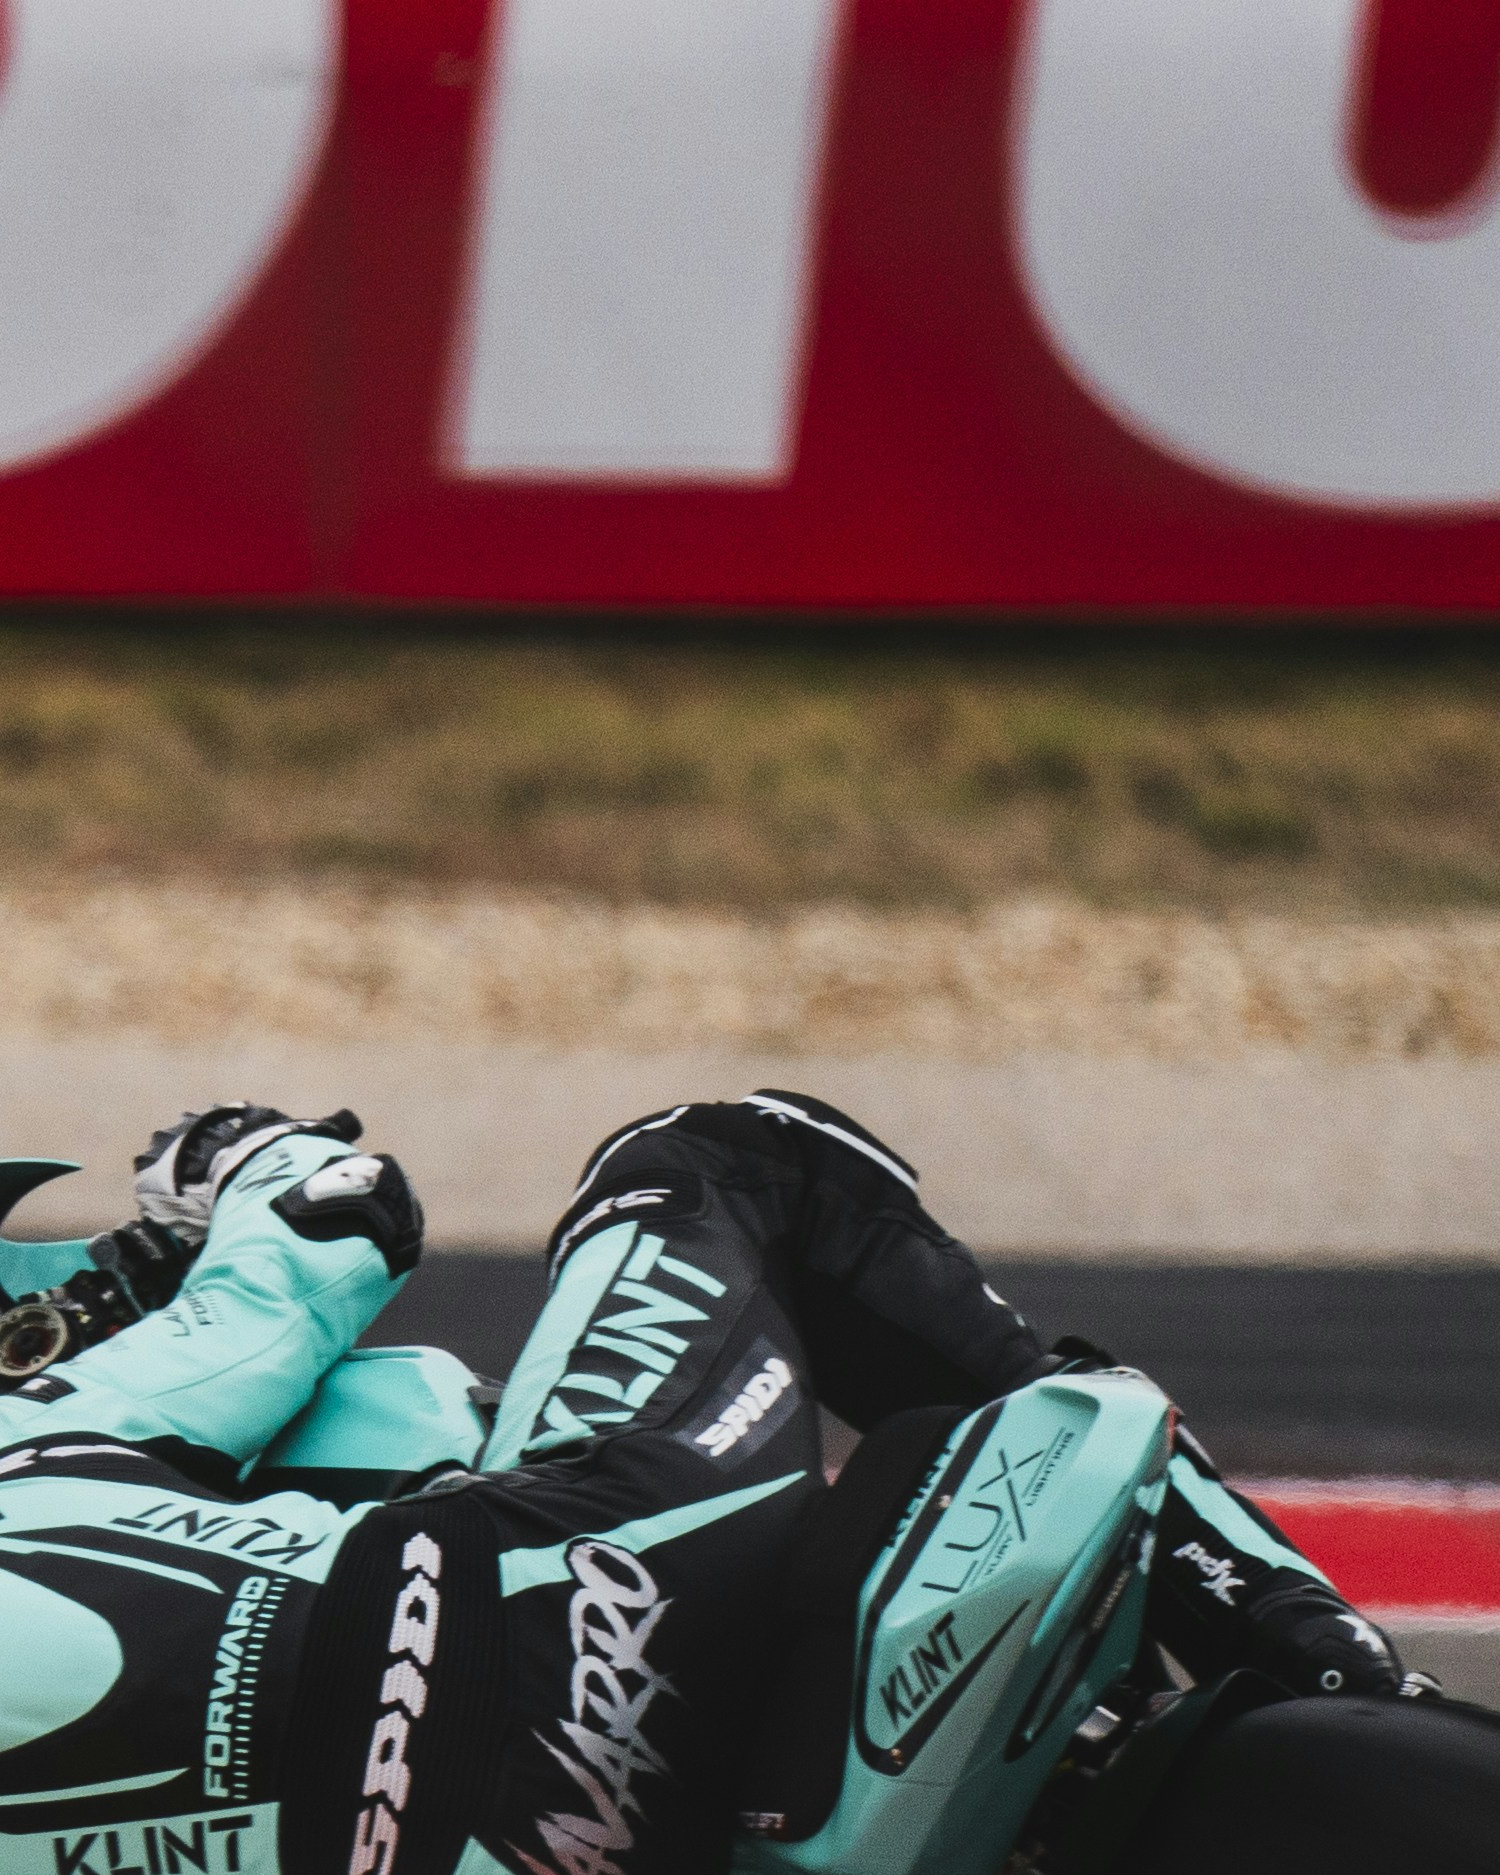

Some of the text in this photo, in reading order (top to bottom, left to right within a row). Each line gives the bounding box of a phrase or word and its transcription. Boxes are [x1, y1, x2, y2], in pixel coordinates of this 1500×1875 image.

[520, 1233, 728, 1453] KLINT
[696, 1357, 792, 1457] SPIDI
[109, 1502, 332, 1566] KLINT
[921, 1448, 1045, 1595] LUX
[204, 1575, 272, 1799] FORWARD
[878, 1610, 966, 1731] KLINT
